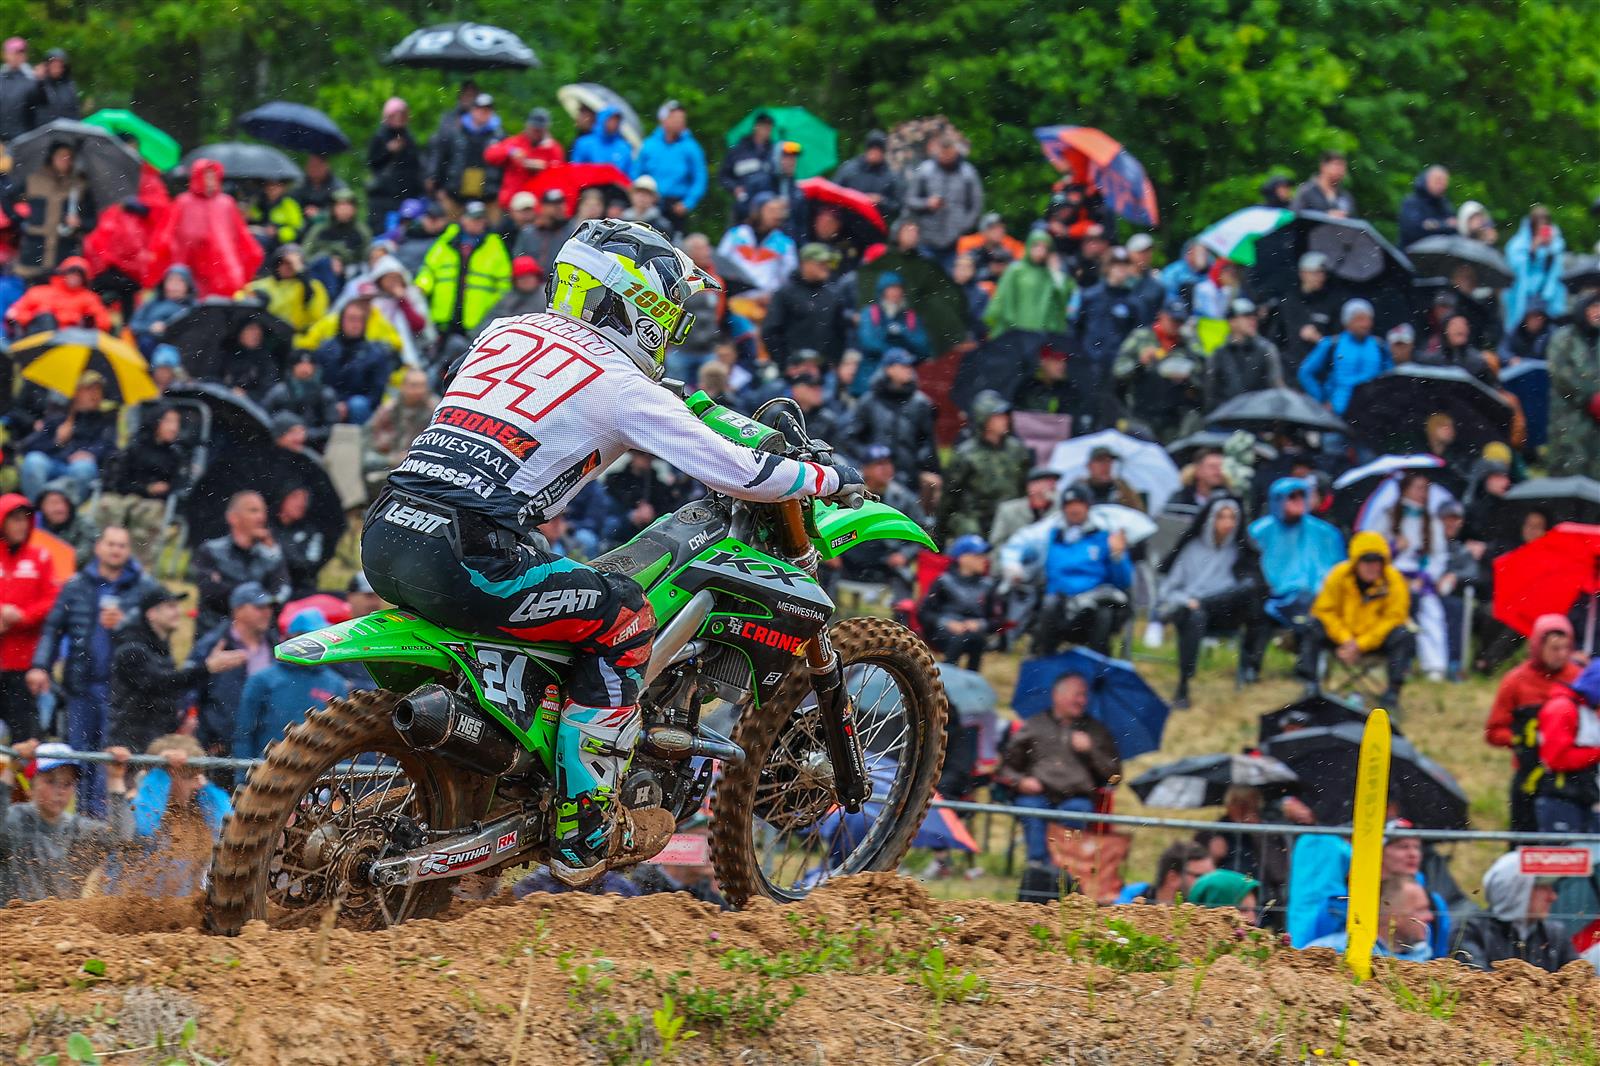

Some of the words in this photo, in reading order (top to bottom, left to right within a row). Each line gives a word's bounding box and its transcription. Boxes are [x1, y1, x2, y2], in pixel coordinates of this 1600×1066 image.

[622, 281, 682, 330] 100%
[637, 323, 661, 345] Arai
[445, 329, 605, 422] 24
[437, 407, 519, 445] CRONE
[384, 503, 453, 534] LEATT
[705, 552, 807, 588] KX
[508, 589, 602, 622] LEATT
[777, 601, 826, 621] MERWESTAAL
[612, 617, 640, 646] LEATT
[741, 622, 802, 653] CRONE
[478, 650, 528, 711] 24
[542, 700, 560, 711] MOTUL
[456, 715, 482, 738] HGS
[849, 736, 861, 776] POLISPORT
[500, 832, 517, 846] RK
[419, 845, 490, 874] RENTHAL
